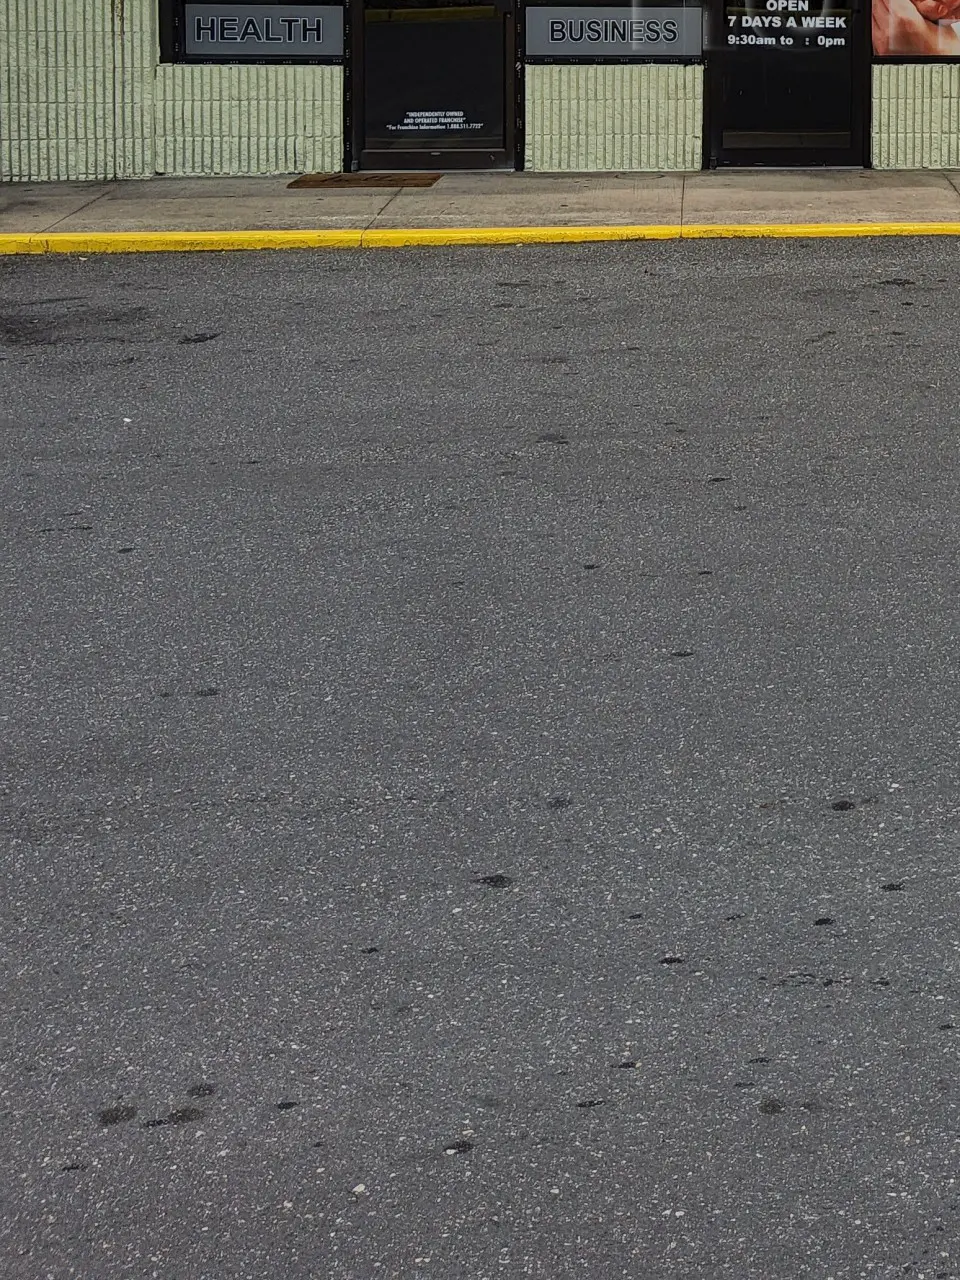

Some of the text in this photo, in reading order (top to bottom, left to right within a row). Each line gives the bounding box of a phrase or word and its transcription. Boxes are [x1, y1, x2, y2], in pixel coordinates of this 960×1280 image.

[766, 0, 809, 12] OPEN
[727, 16, 847, 29] 7 DAYS A WEEK
[194, 16, 323, 43] HEALTH
[549, 19, 679, 44] BUSINESS
[727, 34, 776, 46] 9:30am
[780, 35, 794, 46] to
